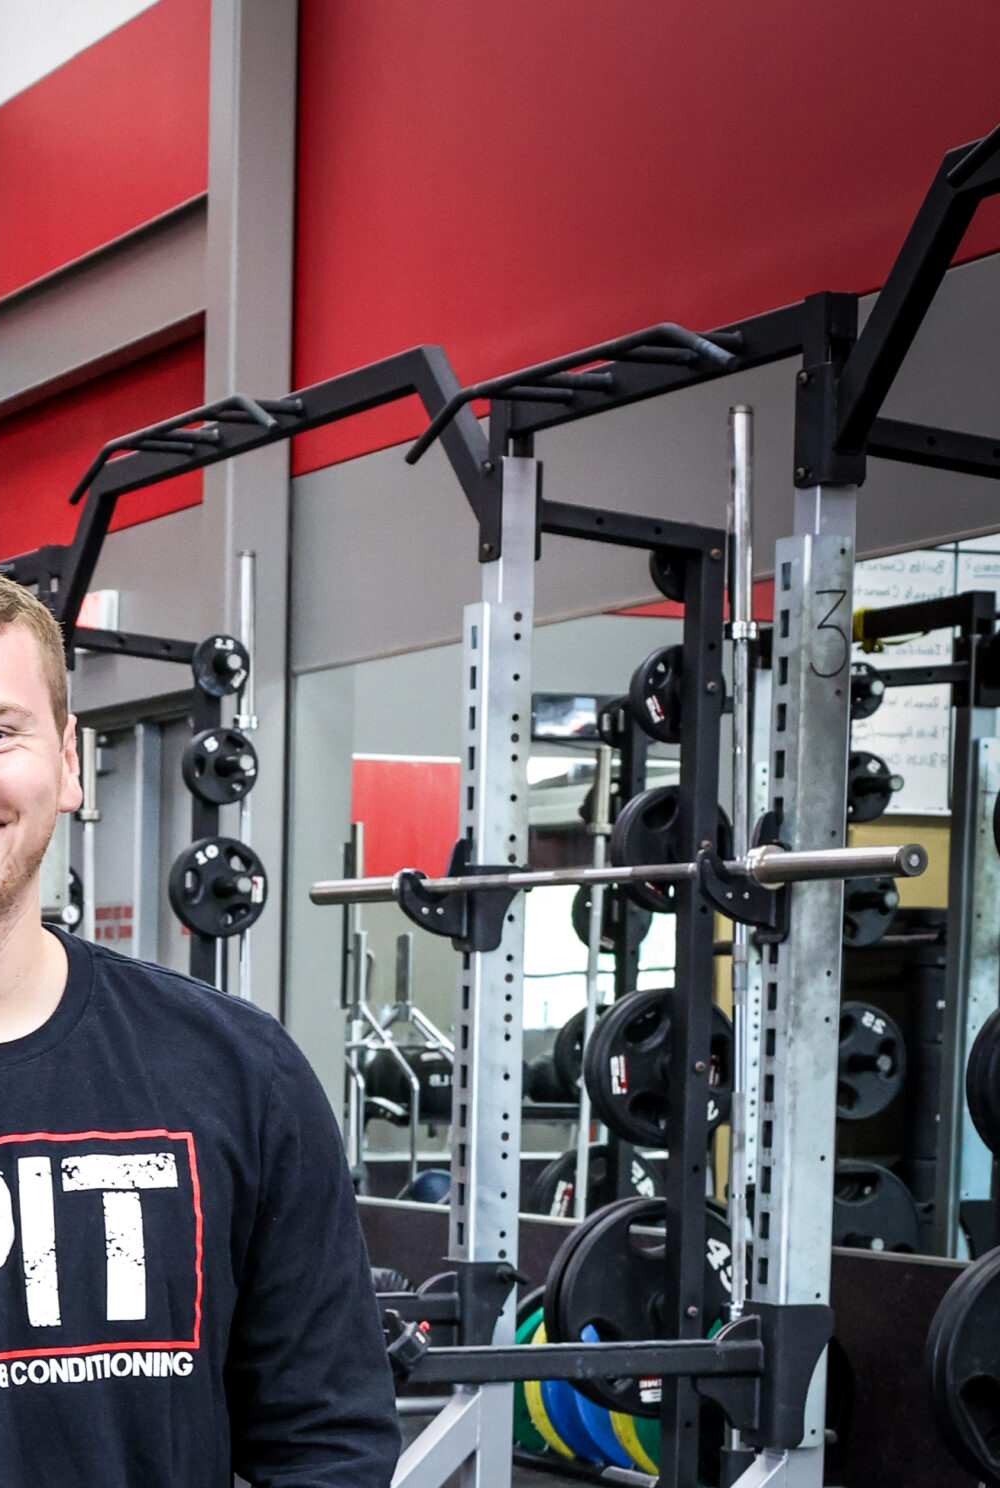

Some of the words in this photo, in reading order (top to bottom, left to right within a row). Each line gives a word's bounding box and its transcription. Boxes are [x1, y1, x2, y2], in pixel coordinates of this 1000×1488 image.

[809, 589, 848, 678] 3
[214, 638, 235, 650] 2.5
[203, 736, 219, 753] 5
[195, 844, 220, 866] 10
